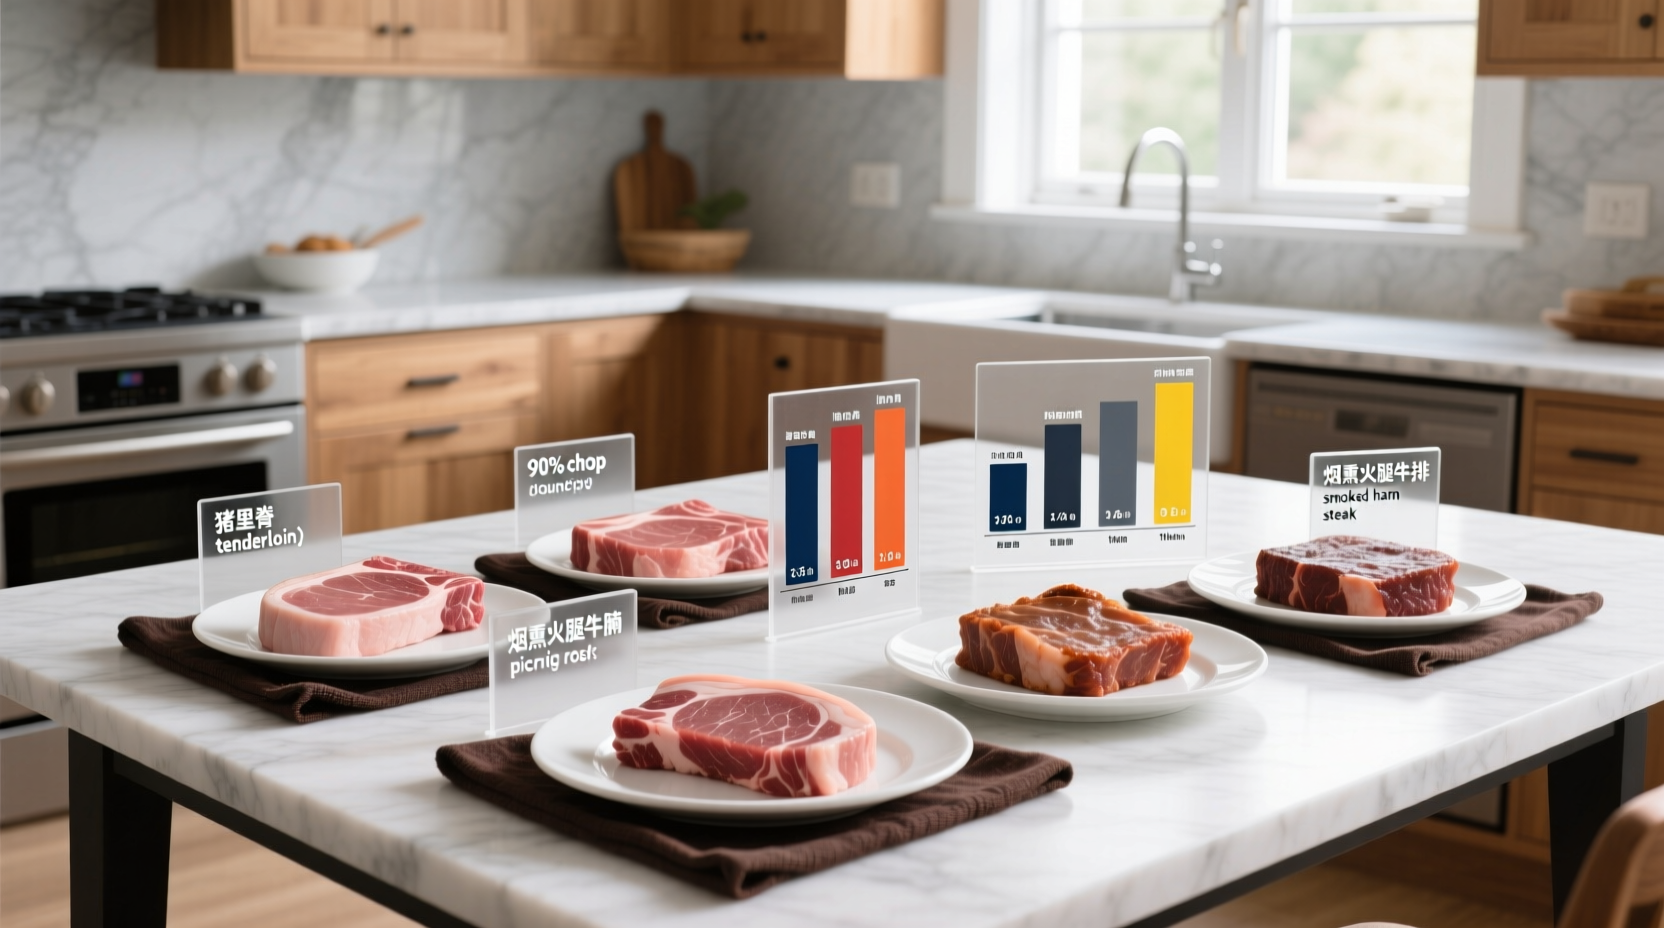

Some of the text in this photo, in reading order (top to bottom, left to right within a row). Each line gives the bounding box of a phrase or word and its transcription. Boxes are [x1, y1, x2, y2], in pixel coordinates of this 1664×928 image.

[527, 452, 607, 478] 90% chop
[1322, 487, 1369, 504] smoked
[214, 505, 274, 535] 猪里脊
[1322, 507, 1357, 521] steak
[215, 526, 304, 554] tenderloin)
